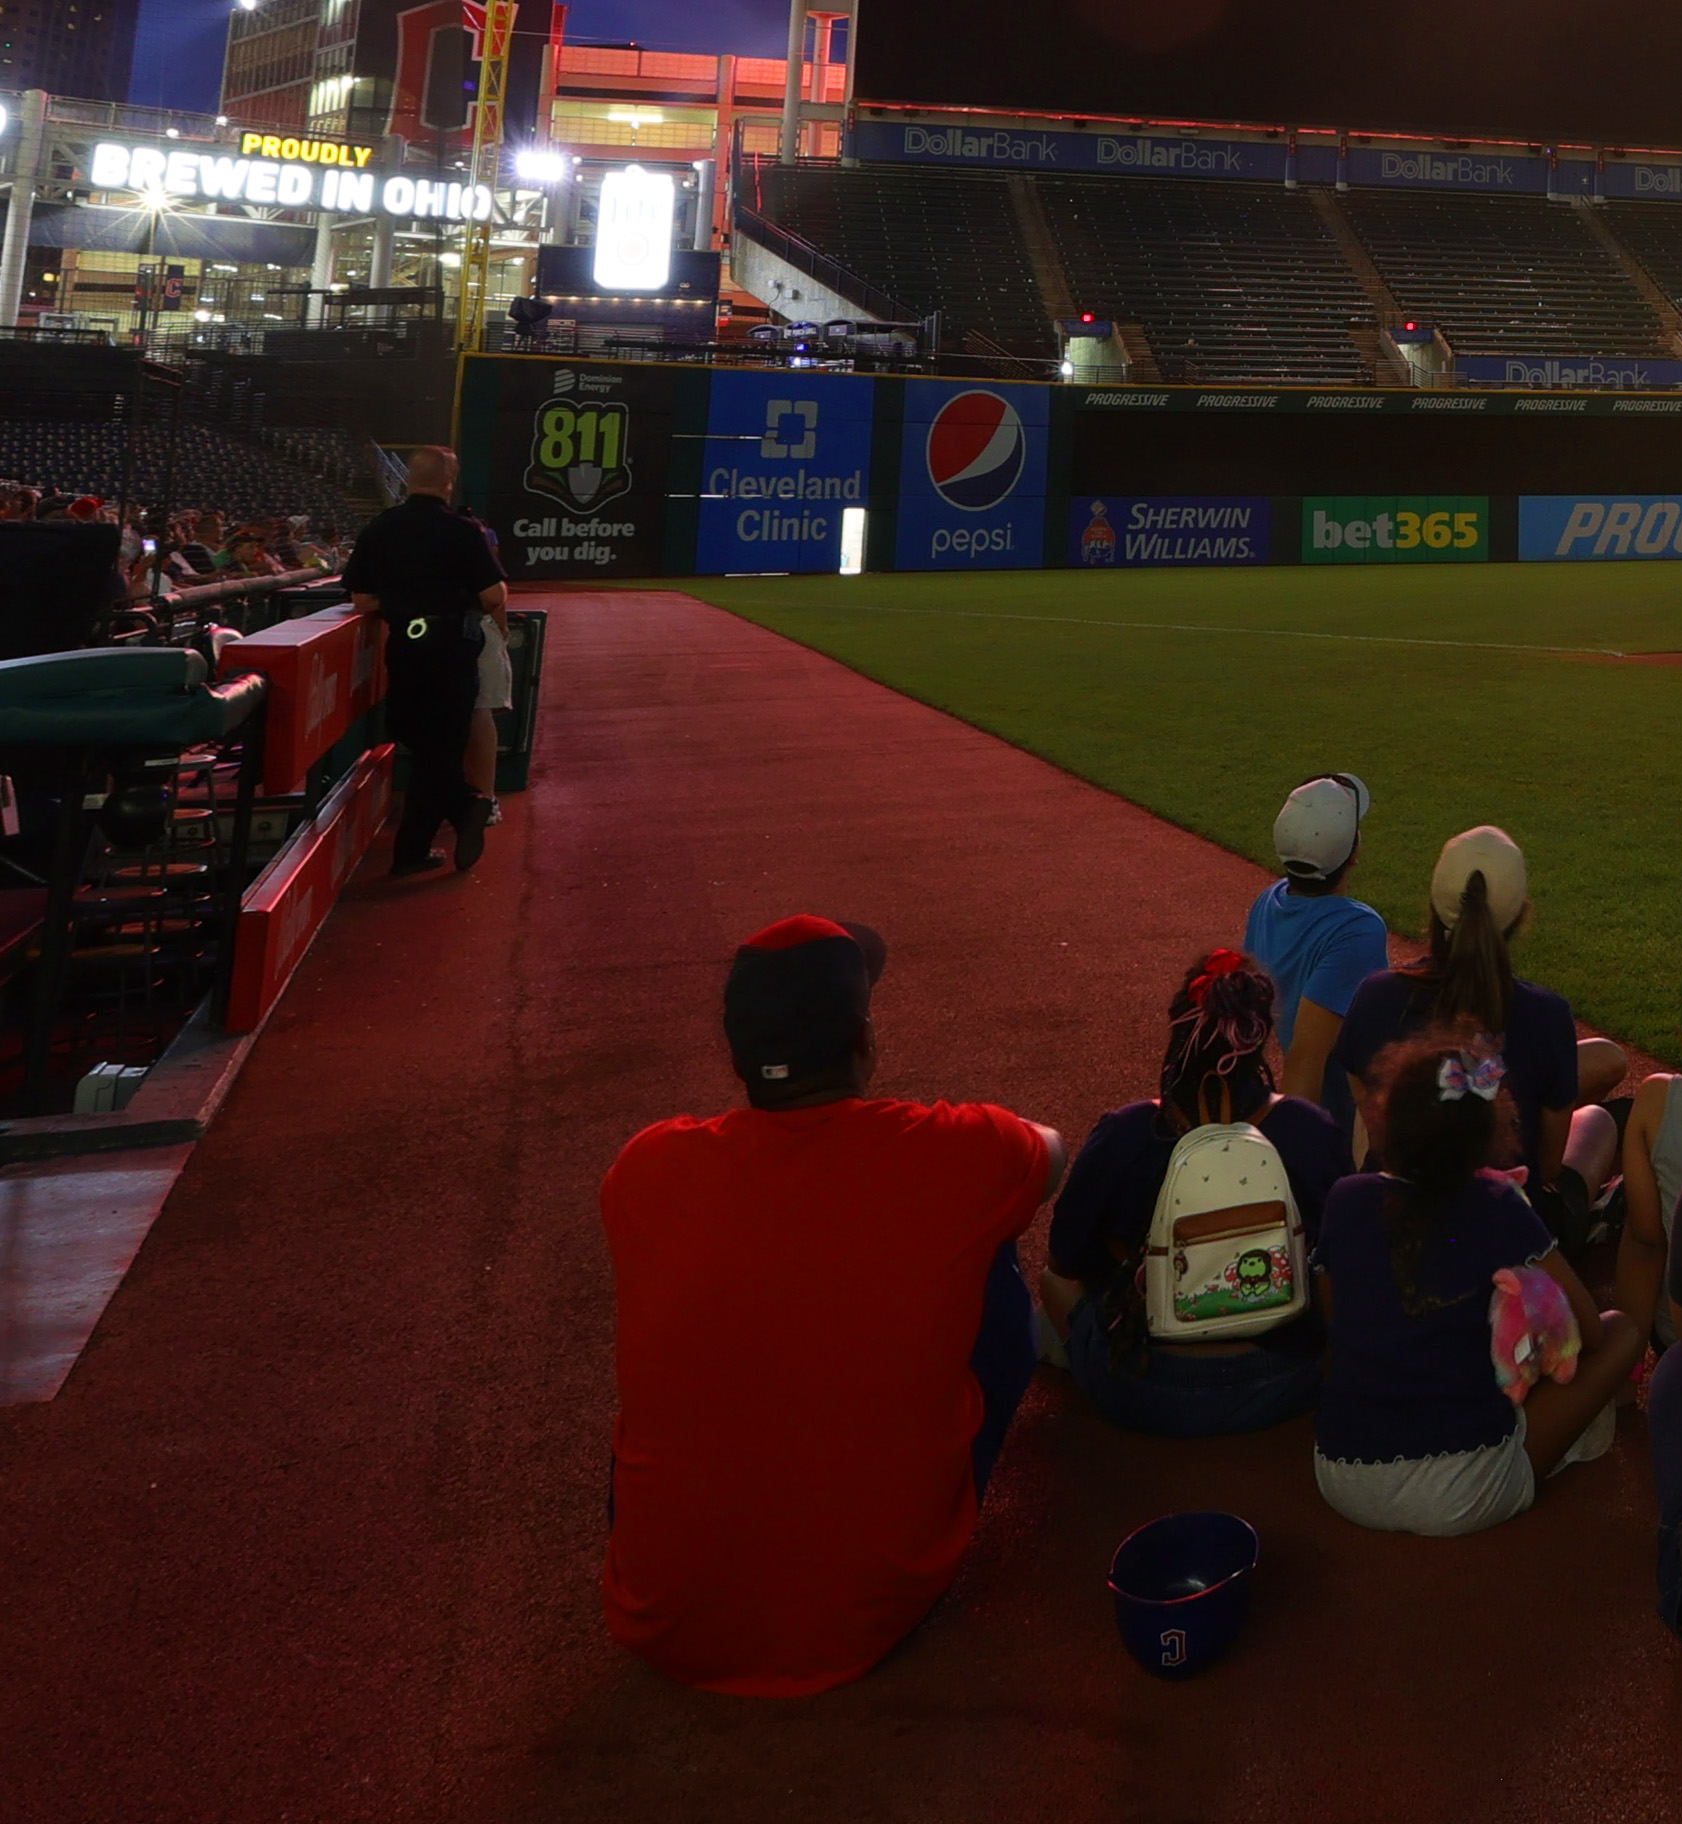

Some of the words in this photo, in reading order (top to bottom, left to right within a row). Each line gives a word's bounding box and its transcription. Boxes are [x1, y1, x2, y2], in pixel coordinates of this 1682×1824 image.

[242, 133, 372, 167] PROUDLY
[904, 127, 1057, 161] DollarBank
[1097, 138, 1240, 171] DollarBank
[92, 143, 311, 206] BREWED
[321, 169, 374, 213] IN
[383, 177, 492, 220] OHIO
[1381, 153, 1514, 185] DollarBank
[579, 373, 622, 384] Dominion
[579, 382, 611, 393] Energy
[1085, 393, 1170, 407] PROGRESSIVE
[1197, 394, 1278, 408] PROGRESSIVE
[1306, 396, 1385, 409] PROGRESSIVE
[1412, 397, 1488, 410] PROGRESSIVE
[1514, 398, 1587, 411] PROGRESSIVE
[540, 407, 621, 468] 811
[709, 467, 861, 500] Cleveland
[513, 518, 557, 537] Call
[561, 518, 635, 537] before
[737, 510, 827, 542] Clinic
[1127, 502, 1251, 531] SHERWIN
[1312, 510, 1478, 549] bet365
[526, 545, 569, 566] you
[574, 542, 616, 565] dig.
[931, 523, 1013, 558] pepsi
[1125, 533, 1250, 561] WILLIAMS
